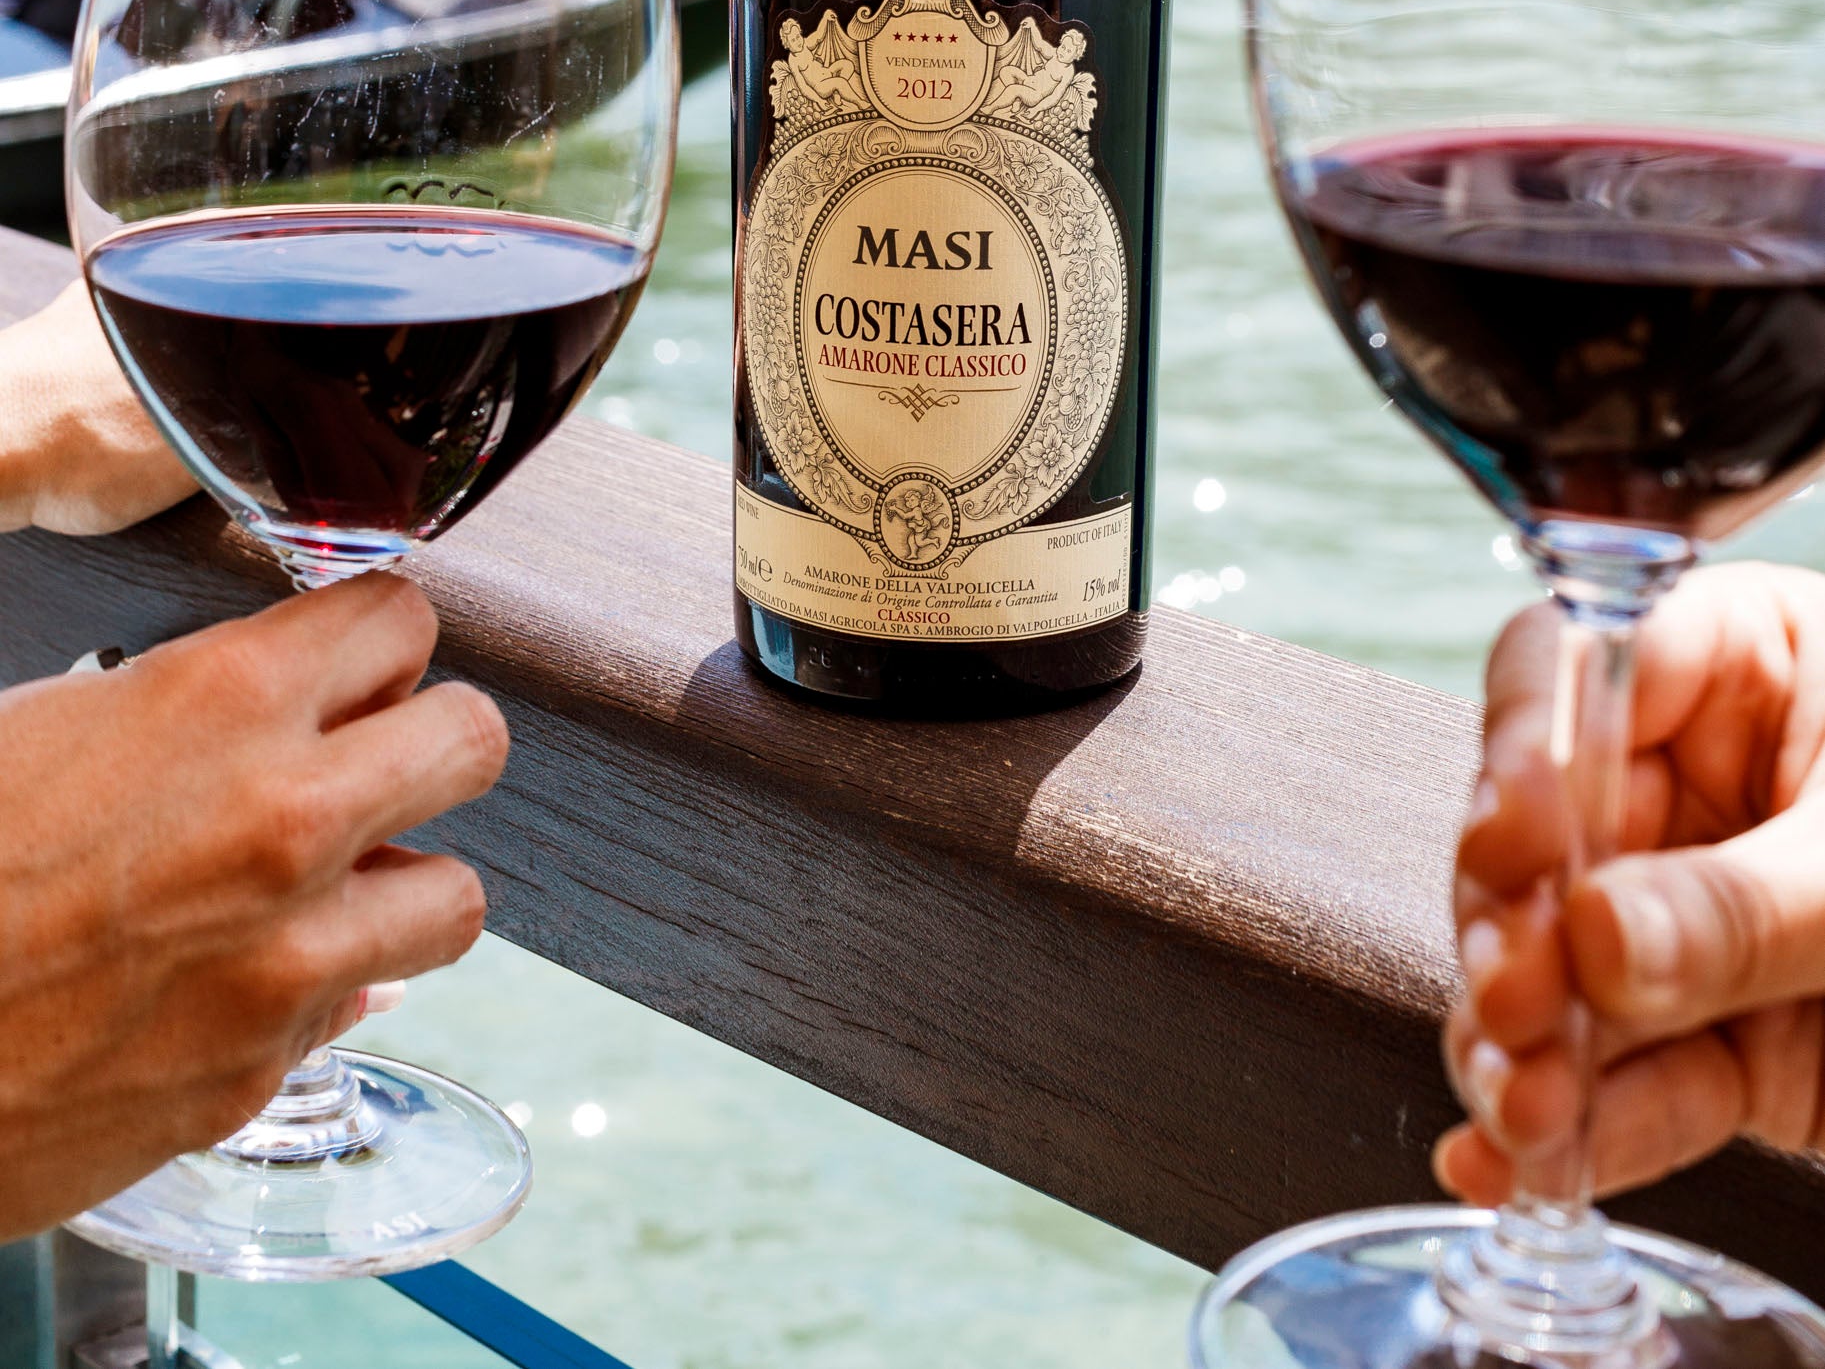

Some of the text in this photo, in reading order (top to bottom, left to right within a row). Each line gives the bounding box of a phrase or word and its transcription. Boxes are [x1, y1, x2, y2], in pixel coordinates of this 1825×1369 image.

[886, 56, 966, 69] VENDEMMIA
[896, 77, 953, 100] 2012
[852, 225, 994, 271] MASI
[815, 293, 1032, 347] COSTASERA
[818, 344, 1027, 378] AMARONE CLASSICO
[746, 502, 760, 520] WINE
[1047, 519, 1122, 550] PRODUCT OF ITALY
[783, 571, 1058, 610] Denominazione di Origine Controllata e Garantita
[804, 565, 1035, 595] AMARONE DELLA VALPOLICELLA
[1082, 569, 1121, 602] 15% vol
[789, 602, 801, 614] DA
[803, 607, 828, 623] MASI
[829, 612, 886, 632] AGRICOLA
[889, 623, 911, 635] SPA
[913, 625, 923, 635] S.
[925, 624, 994, 636] AMBROGIO
[996, 624, 1010, 635] DI
[1012, 612, 1088, 633] VALPOLICELLA
[1094, 601, 1121, 618] ITALIA
[877, 609, 951, 624] CLASSICO
[372, 1211, 429, 1242] ASI
